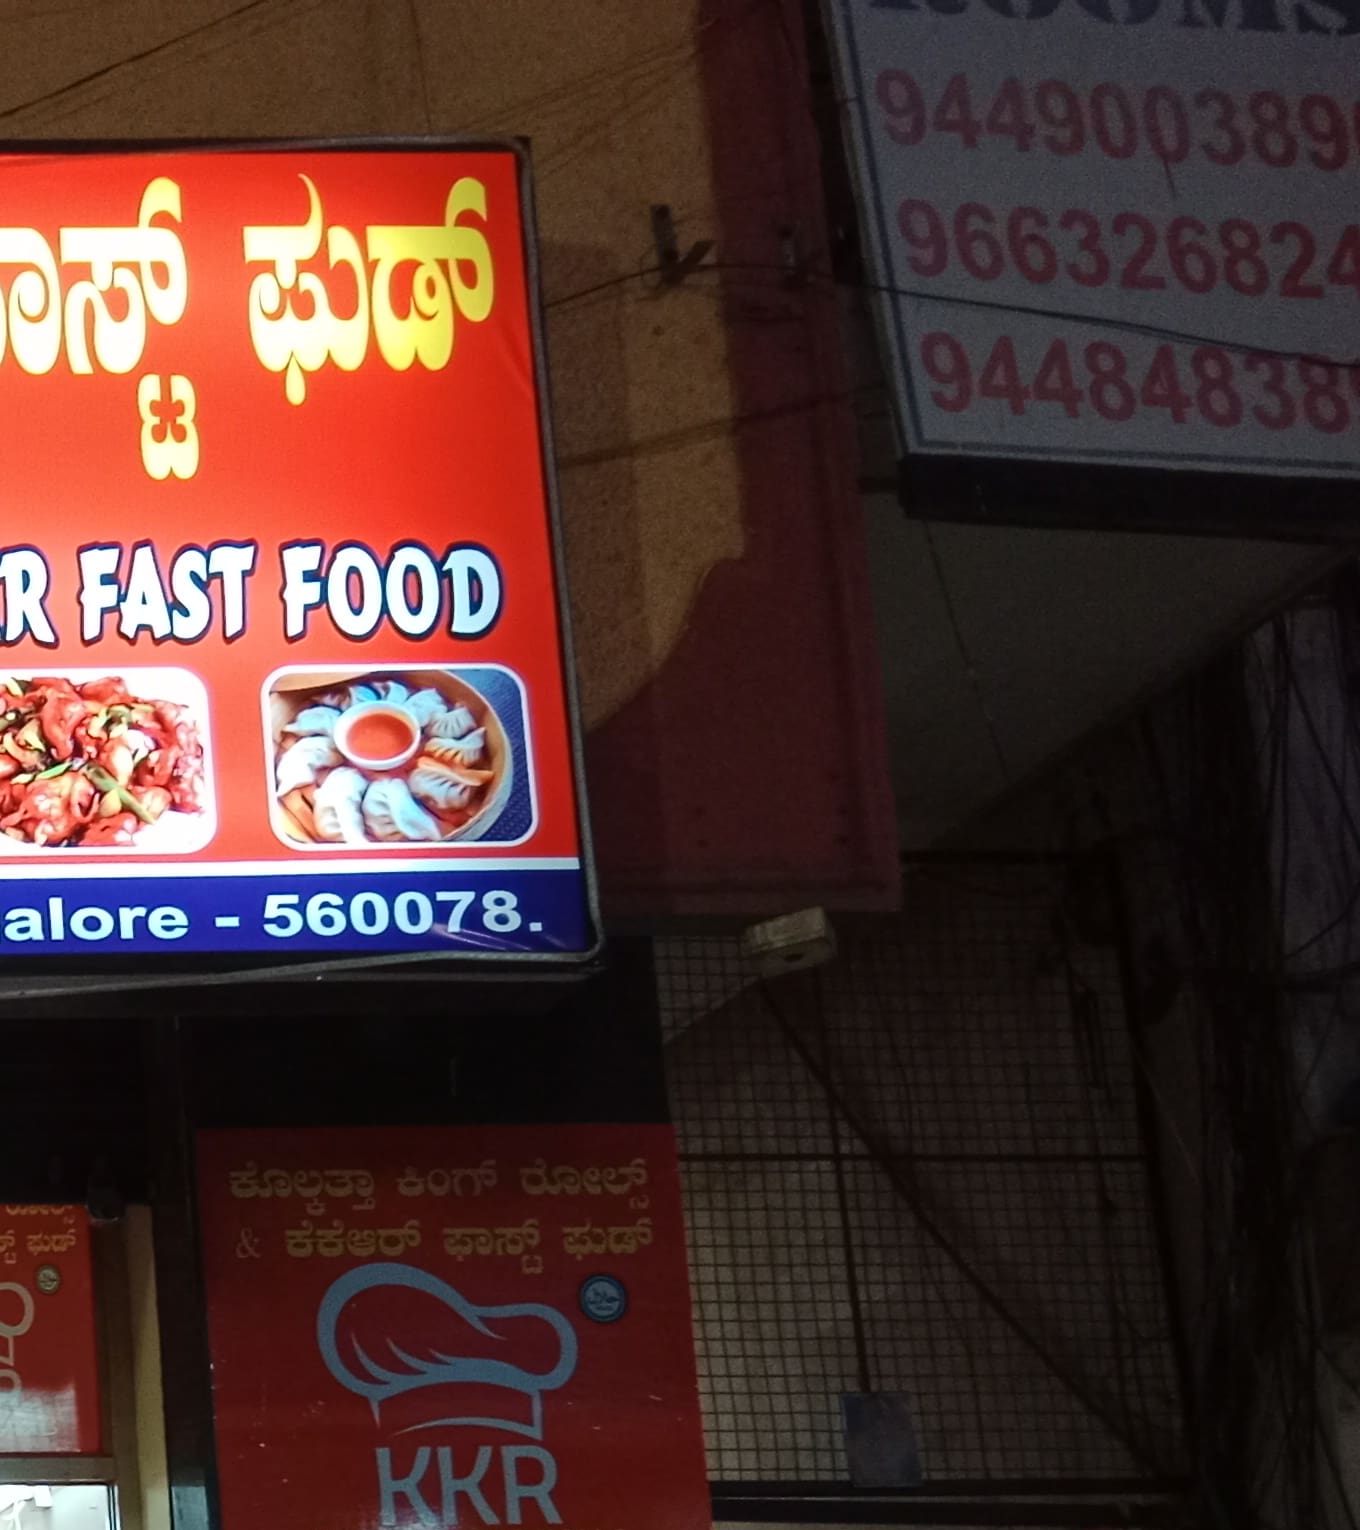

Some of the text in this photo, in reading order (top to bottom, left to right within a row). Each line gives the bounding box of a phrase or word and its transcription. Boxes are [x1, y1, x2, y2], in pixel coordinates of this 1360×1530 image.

[876, 70, 1360, 171] 944900389
[243, 173, 494, 404] ಫುಡ್
[920, 332, 1360, 434] 94484838
[79, 539, 258, 643] FAST
[282, 538, 504, 643] FOOD
[262, 889, 544, 938] 560078.
[236, 1228, 261, 1258] &
[376, 1445, 563, 1525] KKR
